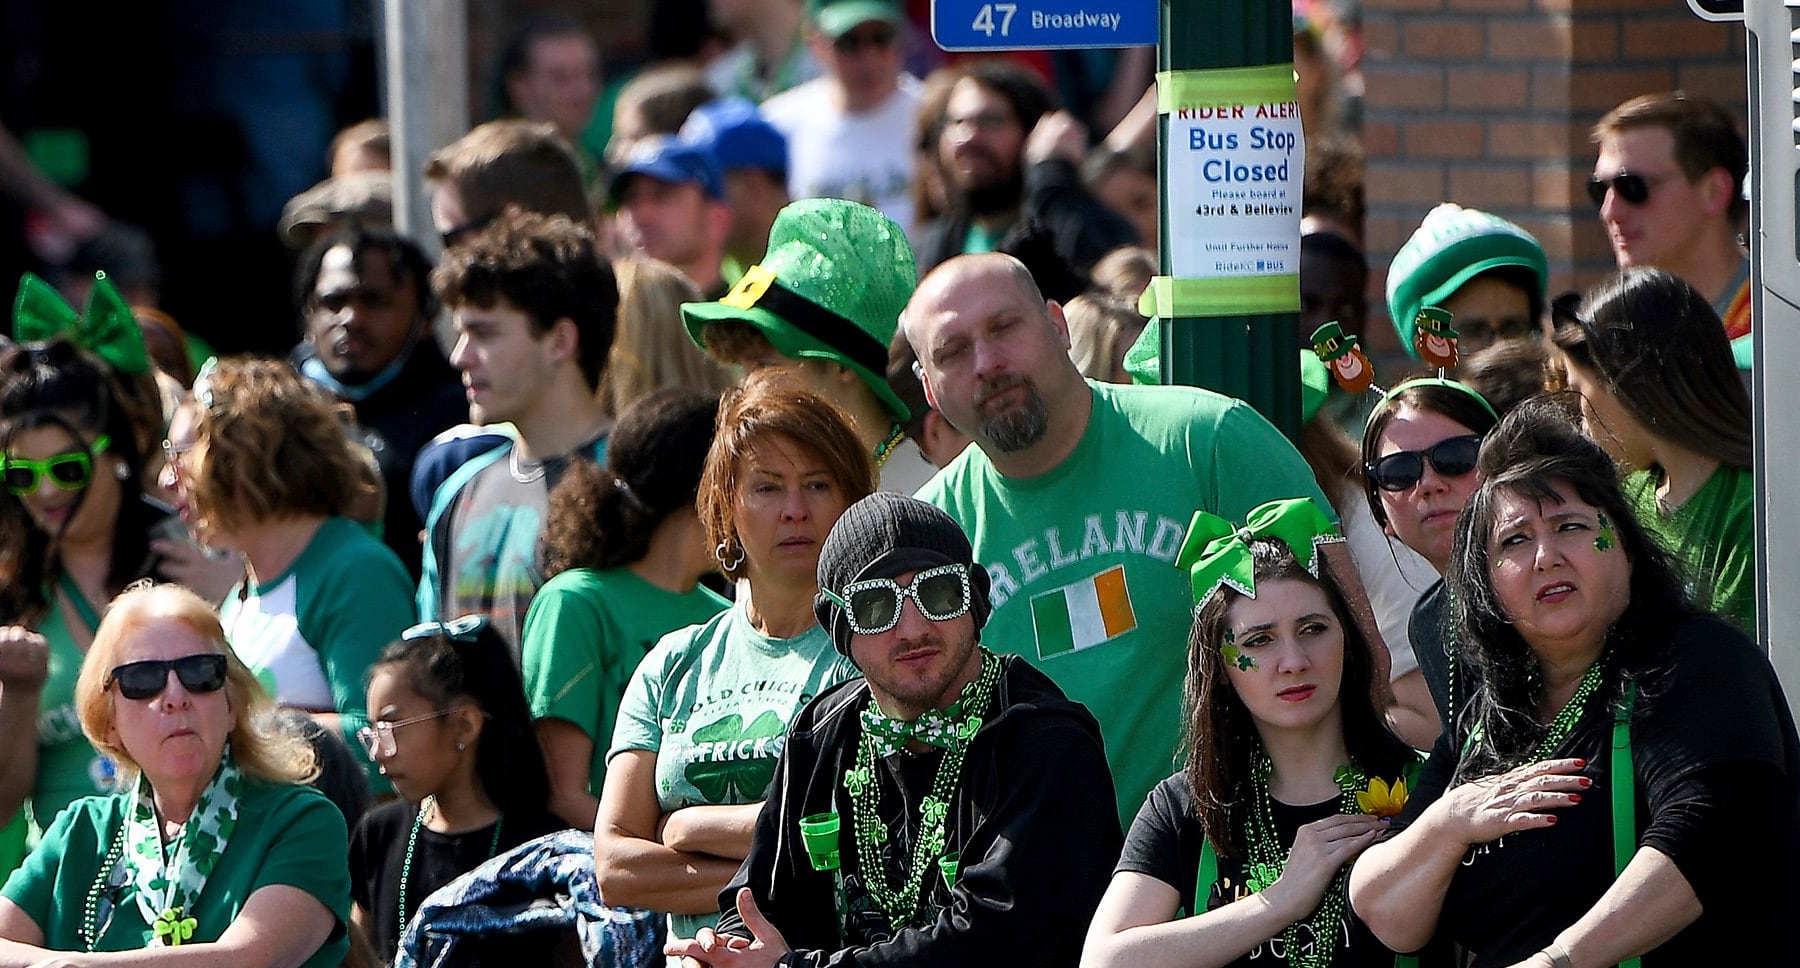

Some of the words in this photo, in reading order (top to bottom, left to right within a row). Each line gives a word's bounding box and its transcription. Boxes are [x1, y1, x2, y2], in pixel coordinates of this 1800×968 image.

[972, 3, 1017, 37] 47
[1031, 10, 1121, 31] Broadway
[1179, 104, 1244, 119] RIDER
[1190, 128, 1238, 150] Bus
[1250, 126, 1295, 155] Stop
[1203, 158, 1288, 181] Closed
[1196, 203, 1224, 216] 43rd
[1230, 203, 1239, 215] &
[1267, 260, 1284, 271] BUS
[988, 510, 1186, 610] RELAND
[689, 689, 733, 714] OLD
